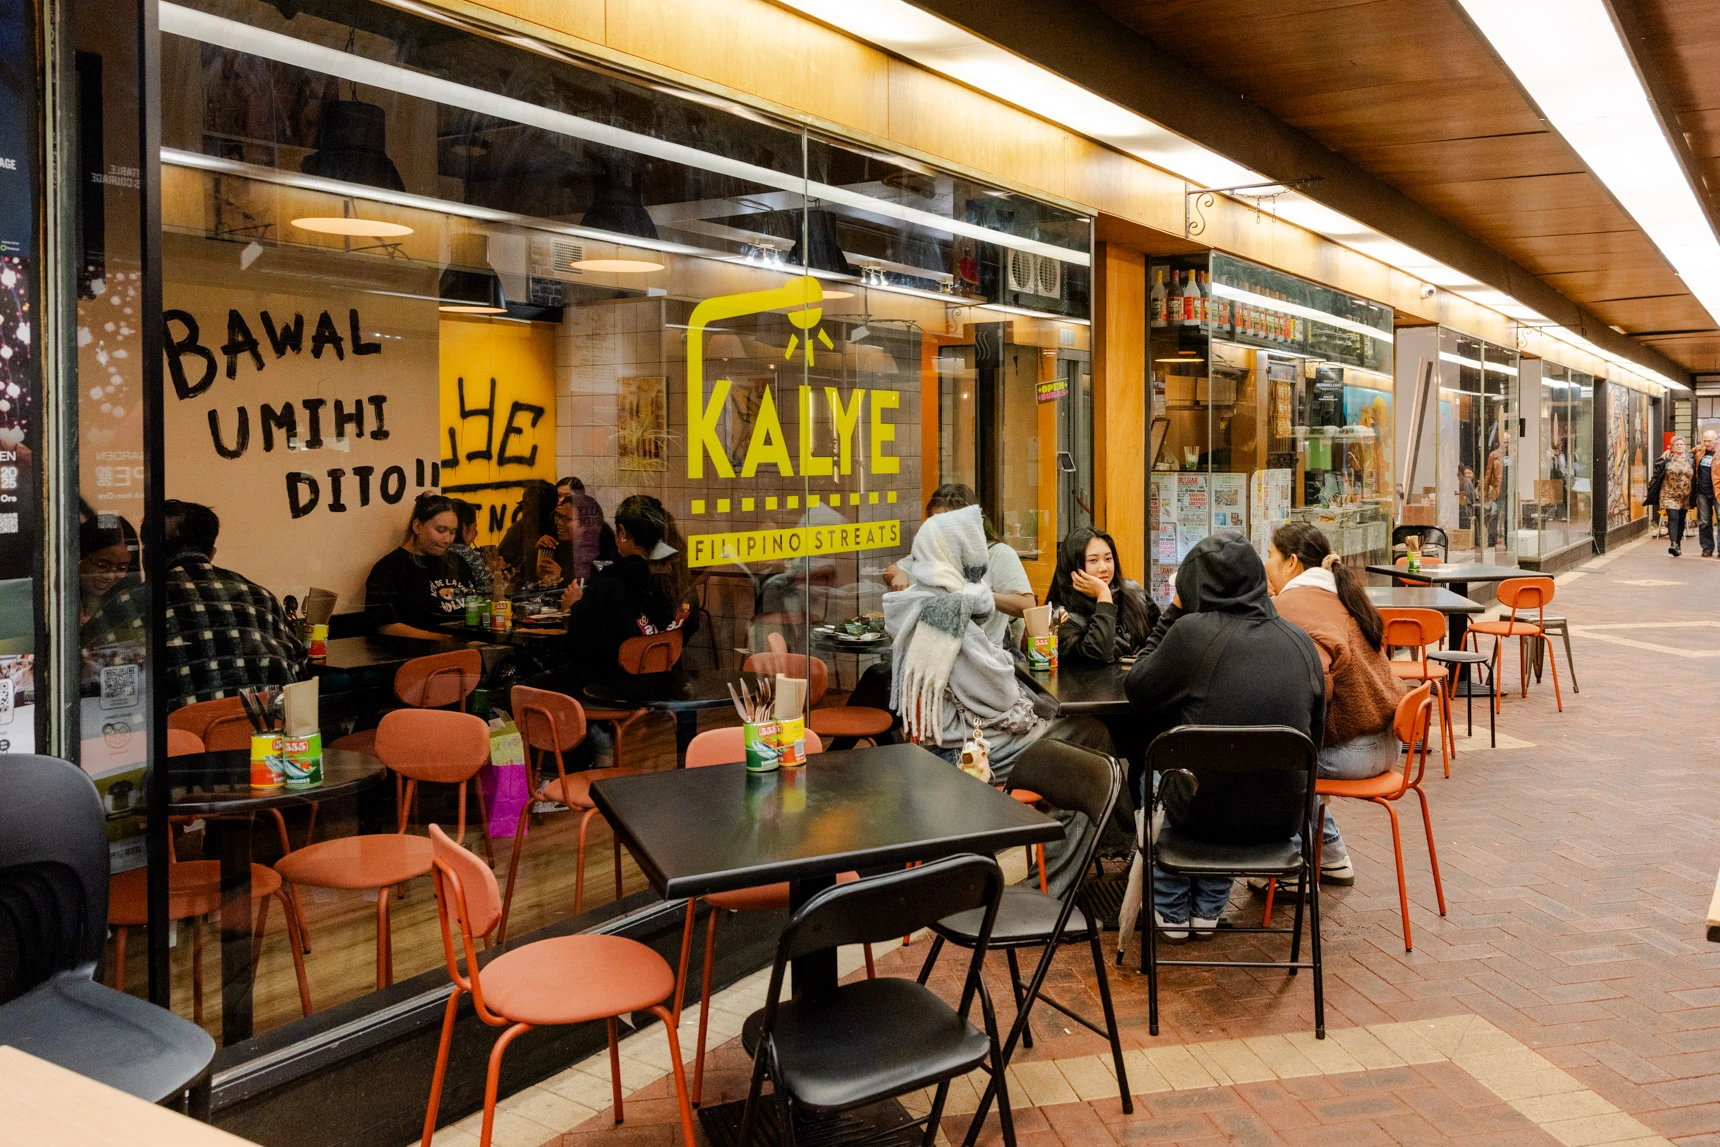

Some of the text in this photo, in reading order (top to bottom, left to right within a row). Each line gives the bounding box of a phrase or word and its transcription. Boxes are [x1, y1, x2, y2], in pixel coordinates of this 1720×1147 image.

[163, 308, 382, 400] BAWAL
[1041, 381, 1065, 393] OPEN
[207, 394, 391, 461] UMIHI
[687, 379, 900, 479] KALYE
[1, 466, 17, 478] 20
[1, 478, 17, 489] 25
[0, 494, 18, 503] Ore
[695, 523, 899, 561] FILIPINO STREATS
[285, 742, 307, 751] 555
